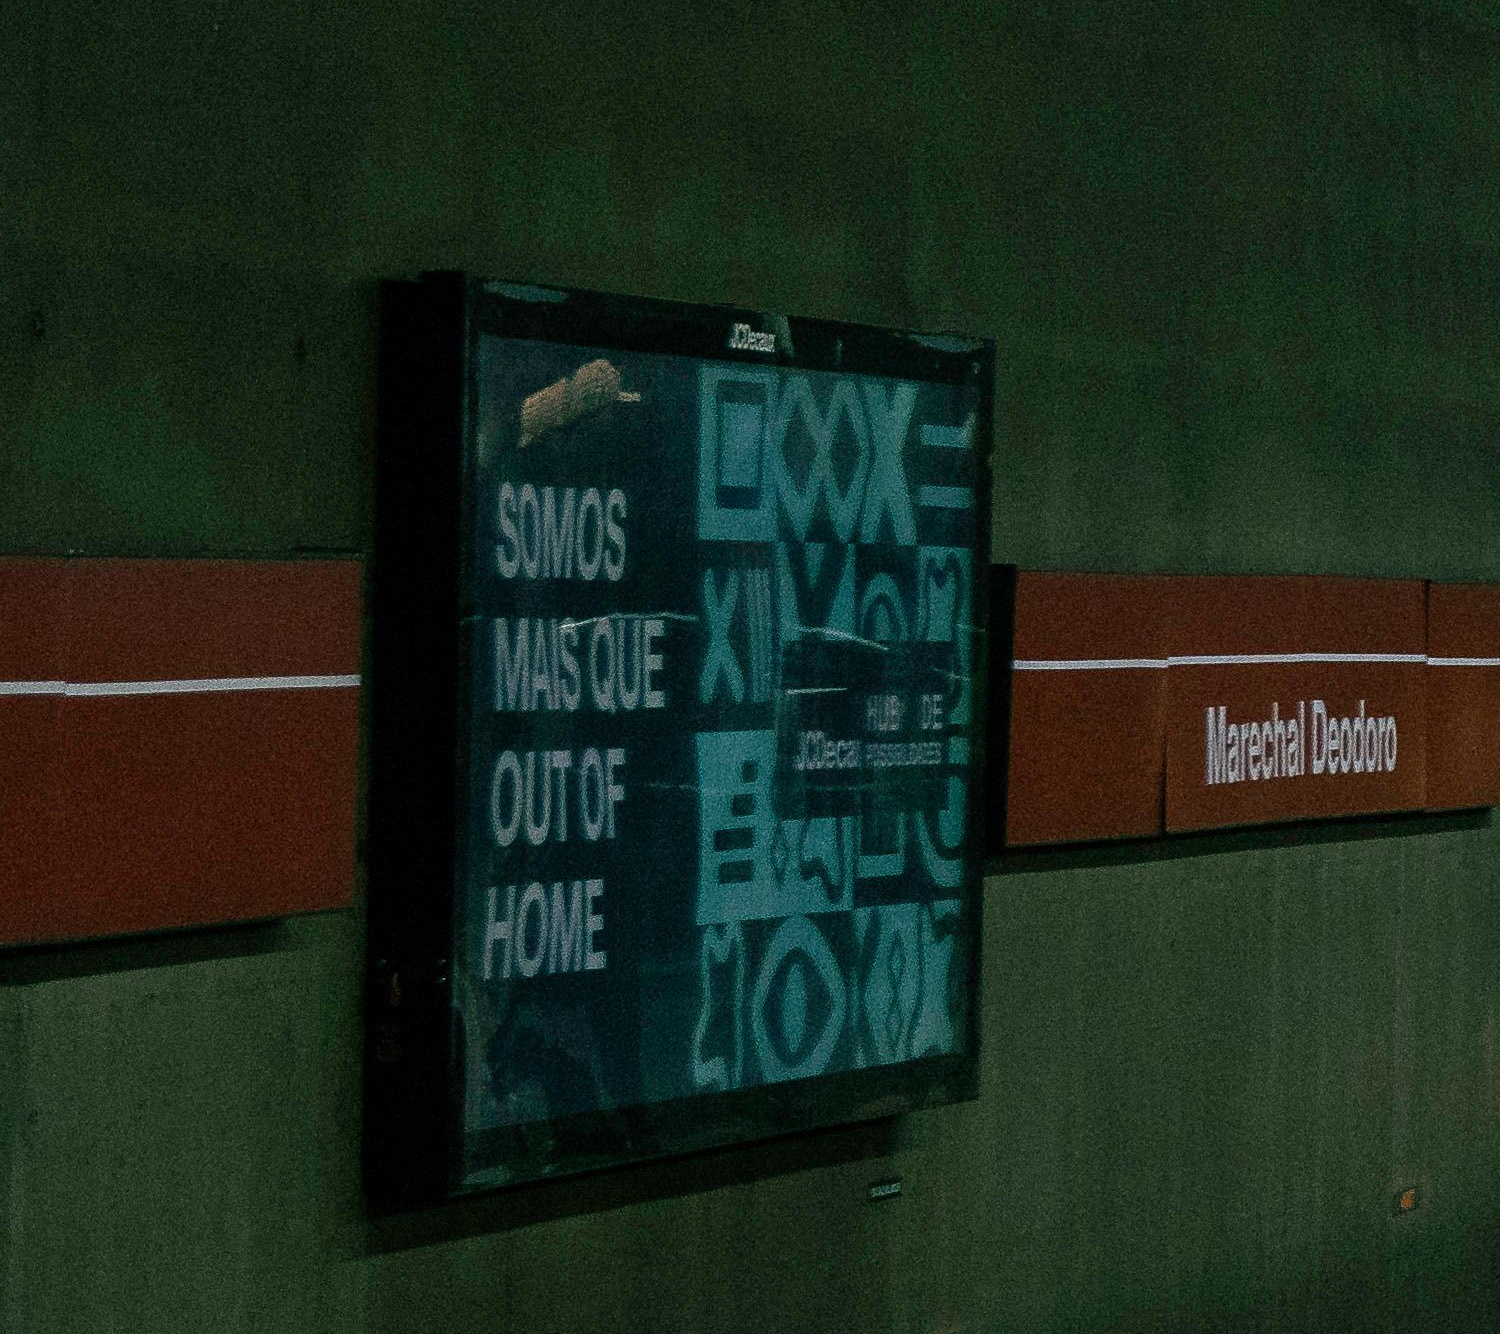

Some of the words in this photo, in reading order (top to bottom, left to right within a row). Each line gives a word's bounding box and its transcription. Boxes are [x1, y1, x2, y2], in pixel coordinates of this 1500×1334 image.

[495, 481, 628, 582] SOMOS
[494, 616, 582, 712] MAIS
[590, 616, 666, 714] QUE
[920, 694, 944, 730] DE
[1205, 701, 1305, 786] Marechal
[1311, 699, 1398, 775] Deodoro
[490, 749, 572, 848] OUT
[579, 747, 627, 842] OF
[482, 878, 608, 981] HOME
